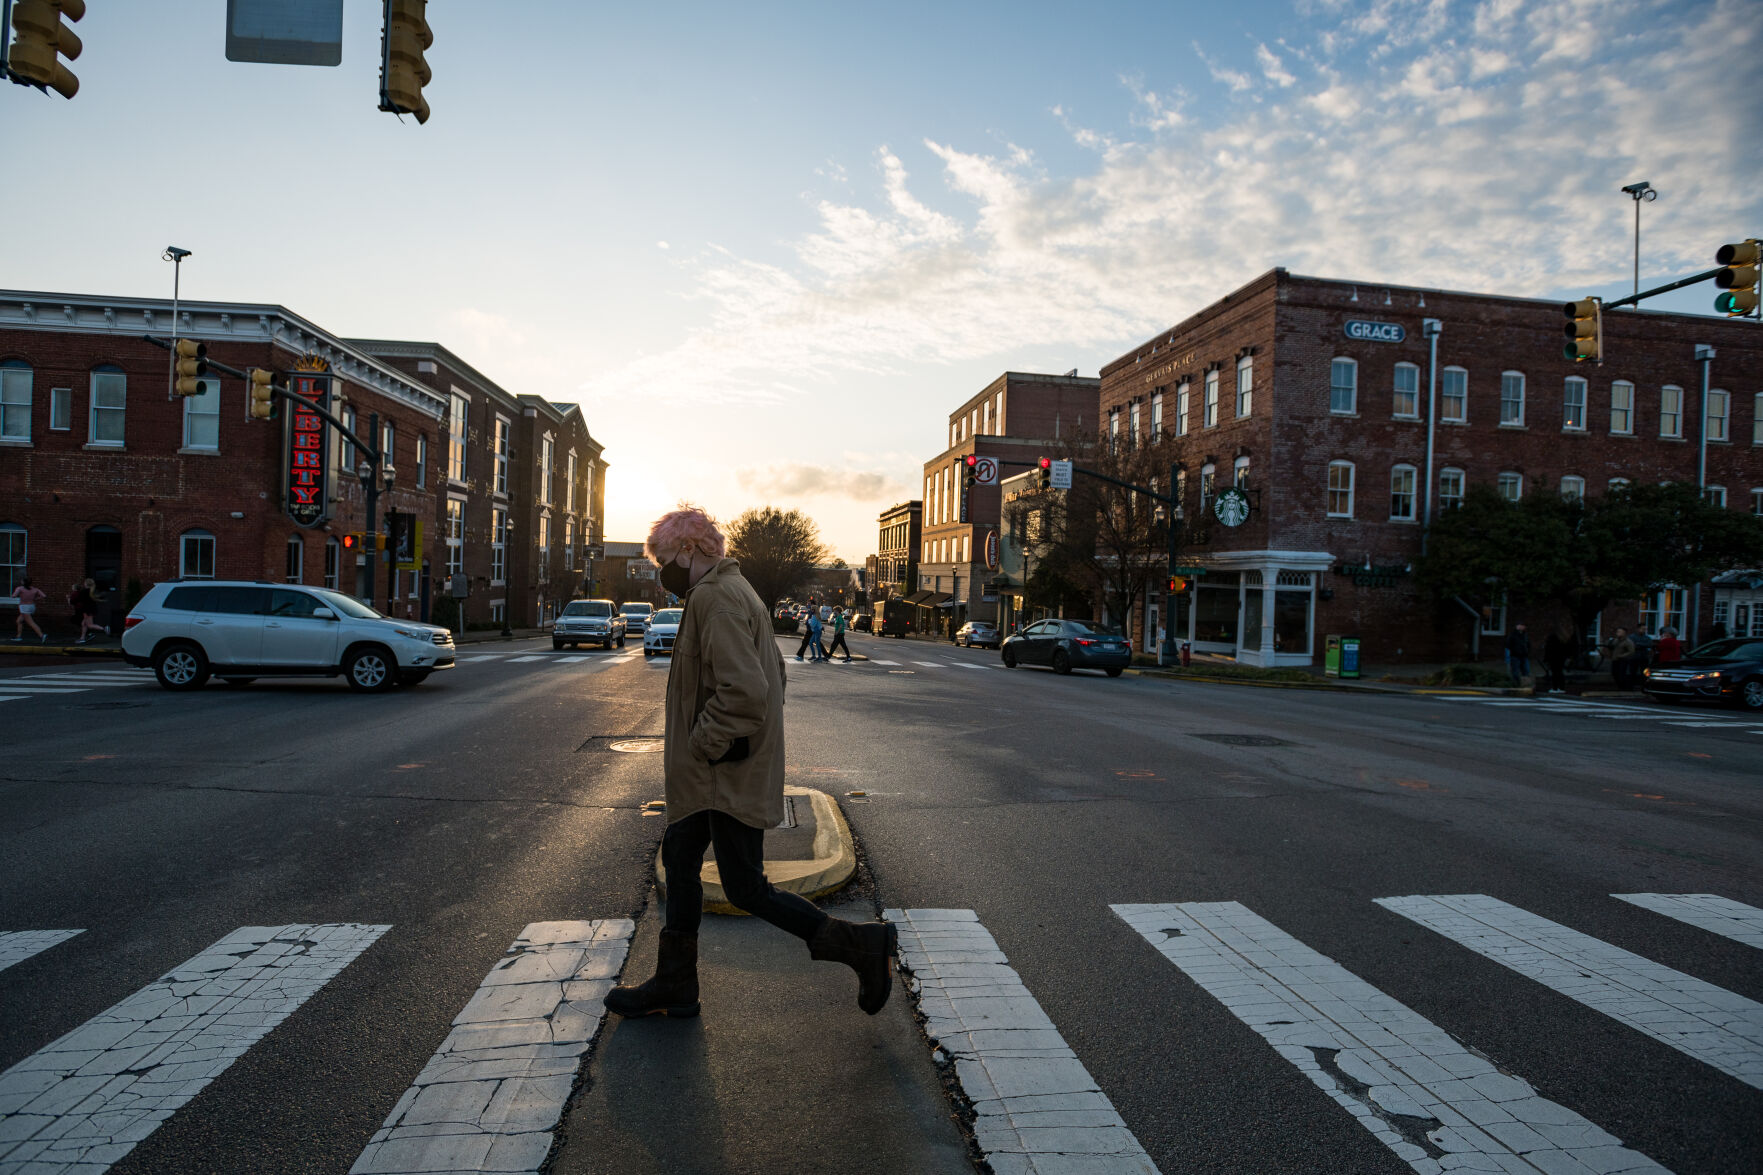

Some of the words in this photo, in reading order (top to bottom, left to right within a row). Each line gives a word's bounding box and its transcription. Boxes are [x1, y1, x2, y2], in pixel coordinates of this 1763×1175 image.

[1350, 322, 1400, 340] GRACE
[1145, 363, 1172, 384] GERVAIS
[291, 378, 322, 503] LIBERTY
